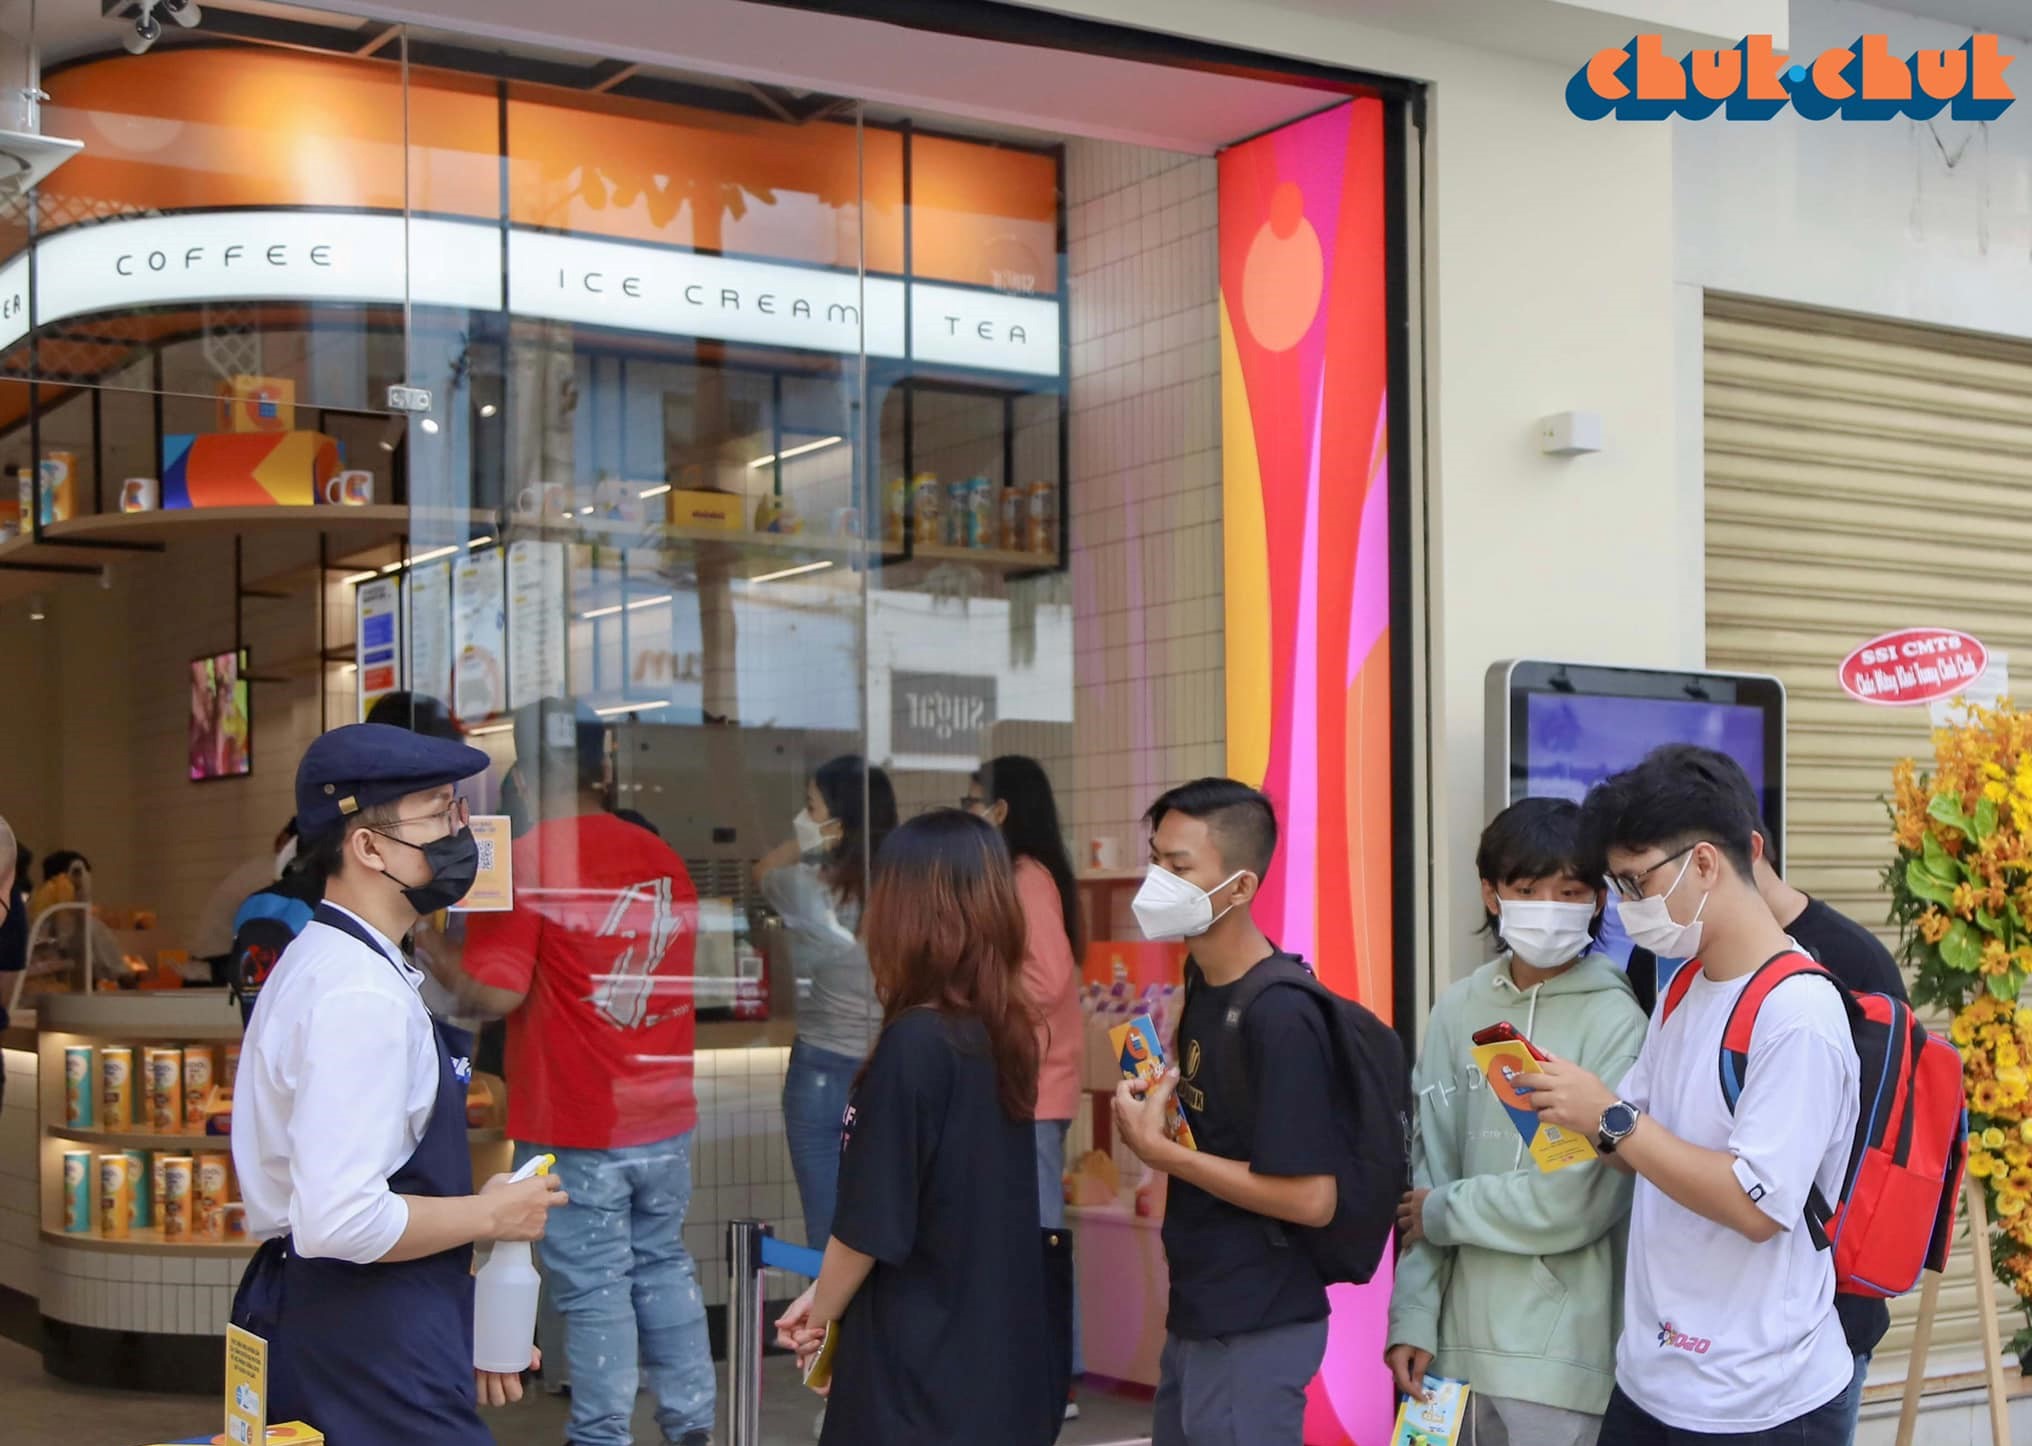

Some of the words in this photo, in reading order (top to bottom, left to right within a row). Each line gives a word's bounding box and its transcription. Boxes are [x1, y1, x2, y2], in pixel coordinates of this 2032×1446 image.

[116, 244, 331, 276] COFFEE
[560, 268, 640, 297] ICE
[685, 285, 859, 325] CREAM
[944, 316, 1026, 344] TEA
[1860, 645, 1898, 666] SSI
